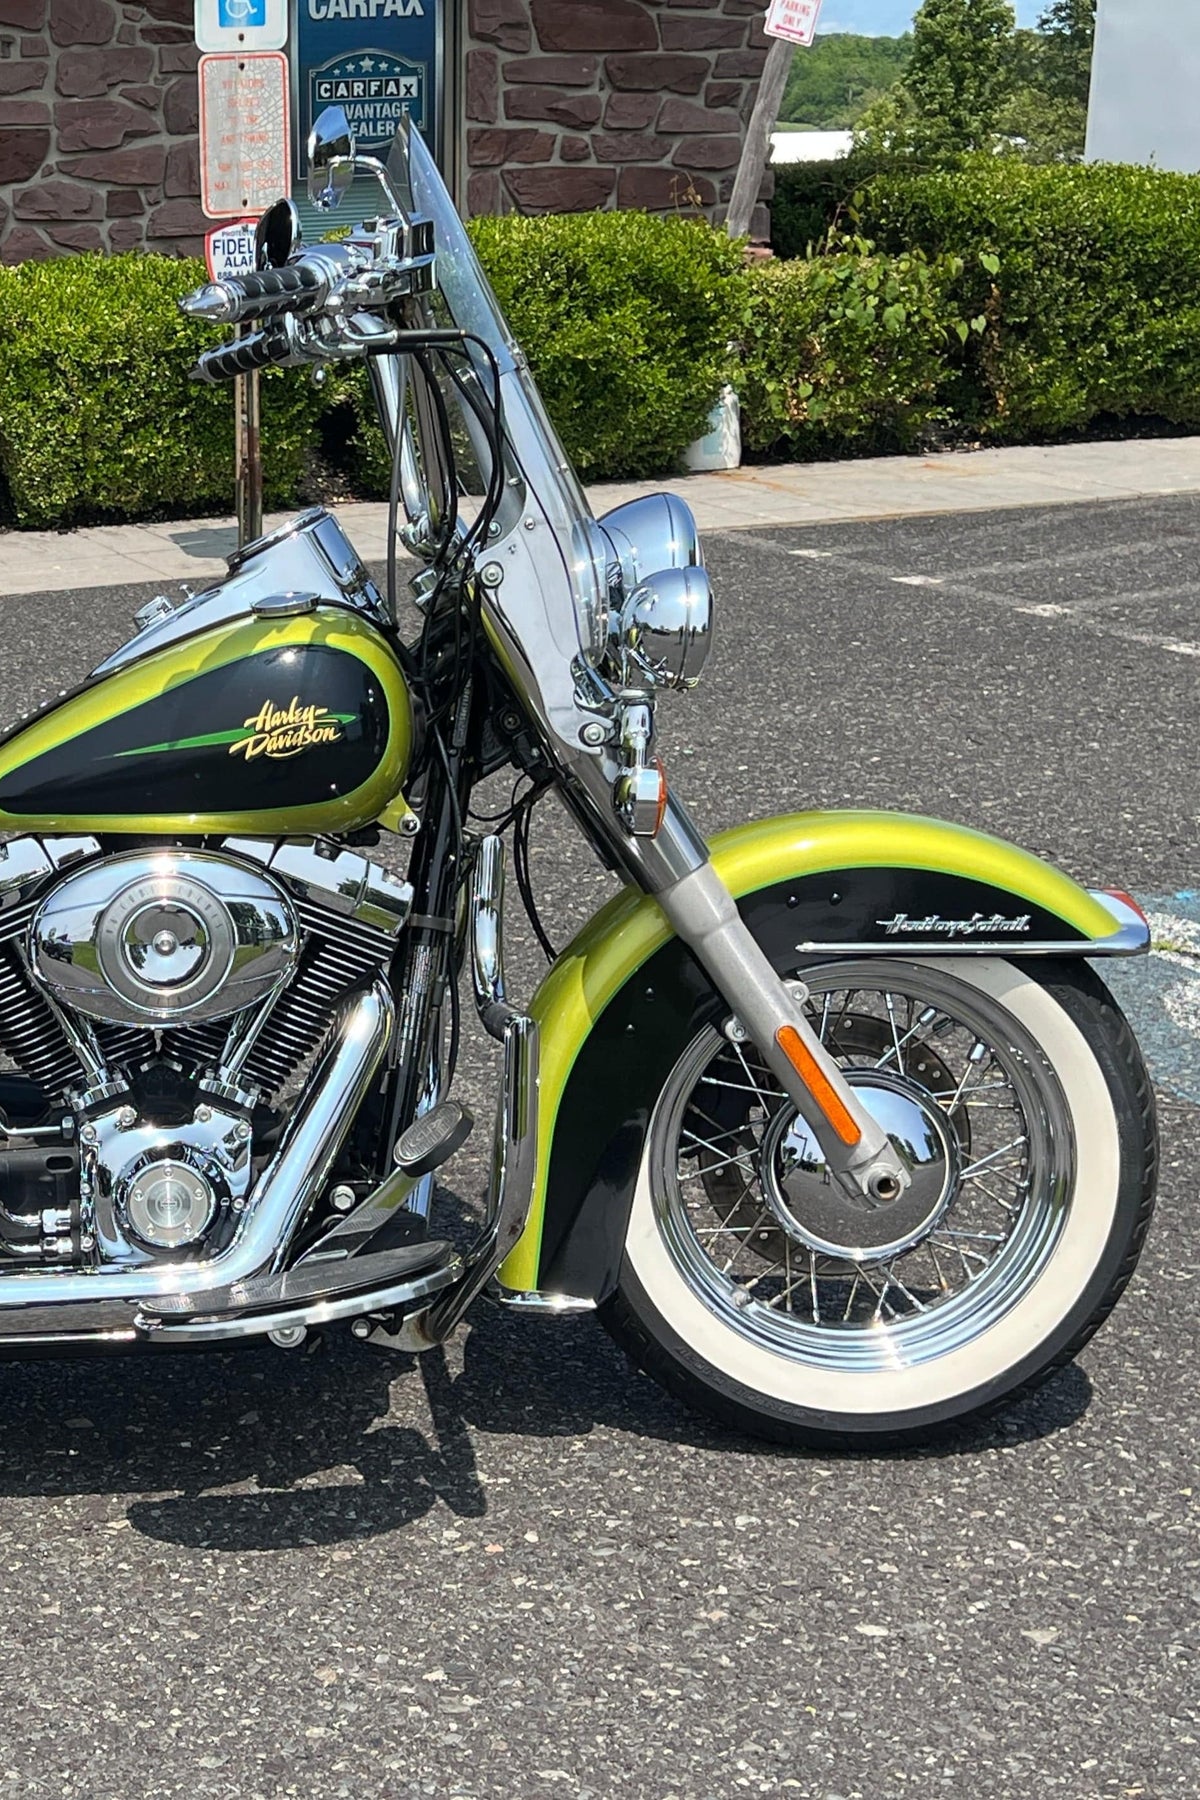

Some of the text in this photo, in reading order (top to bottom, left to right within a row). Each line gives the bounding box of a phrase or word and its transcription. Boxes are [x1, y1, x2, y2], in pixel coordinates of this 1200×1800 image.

[308, 0, 425, 20] CARFAX
[319, 80, 414, 98] CARFAX
[344, 102, 410, 119] VANTAGE
[351, 121, 396, 137] EALER
[212, 237, 254, 256] FIDEL
[228, 724, 342, 760] Davidson
